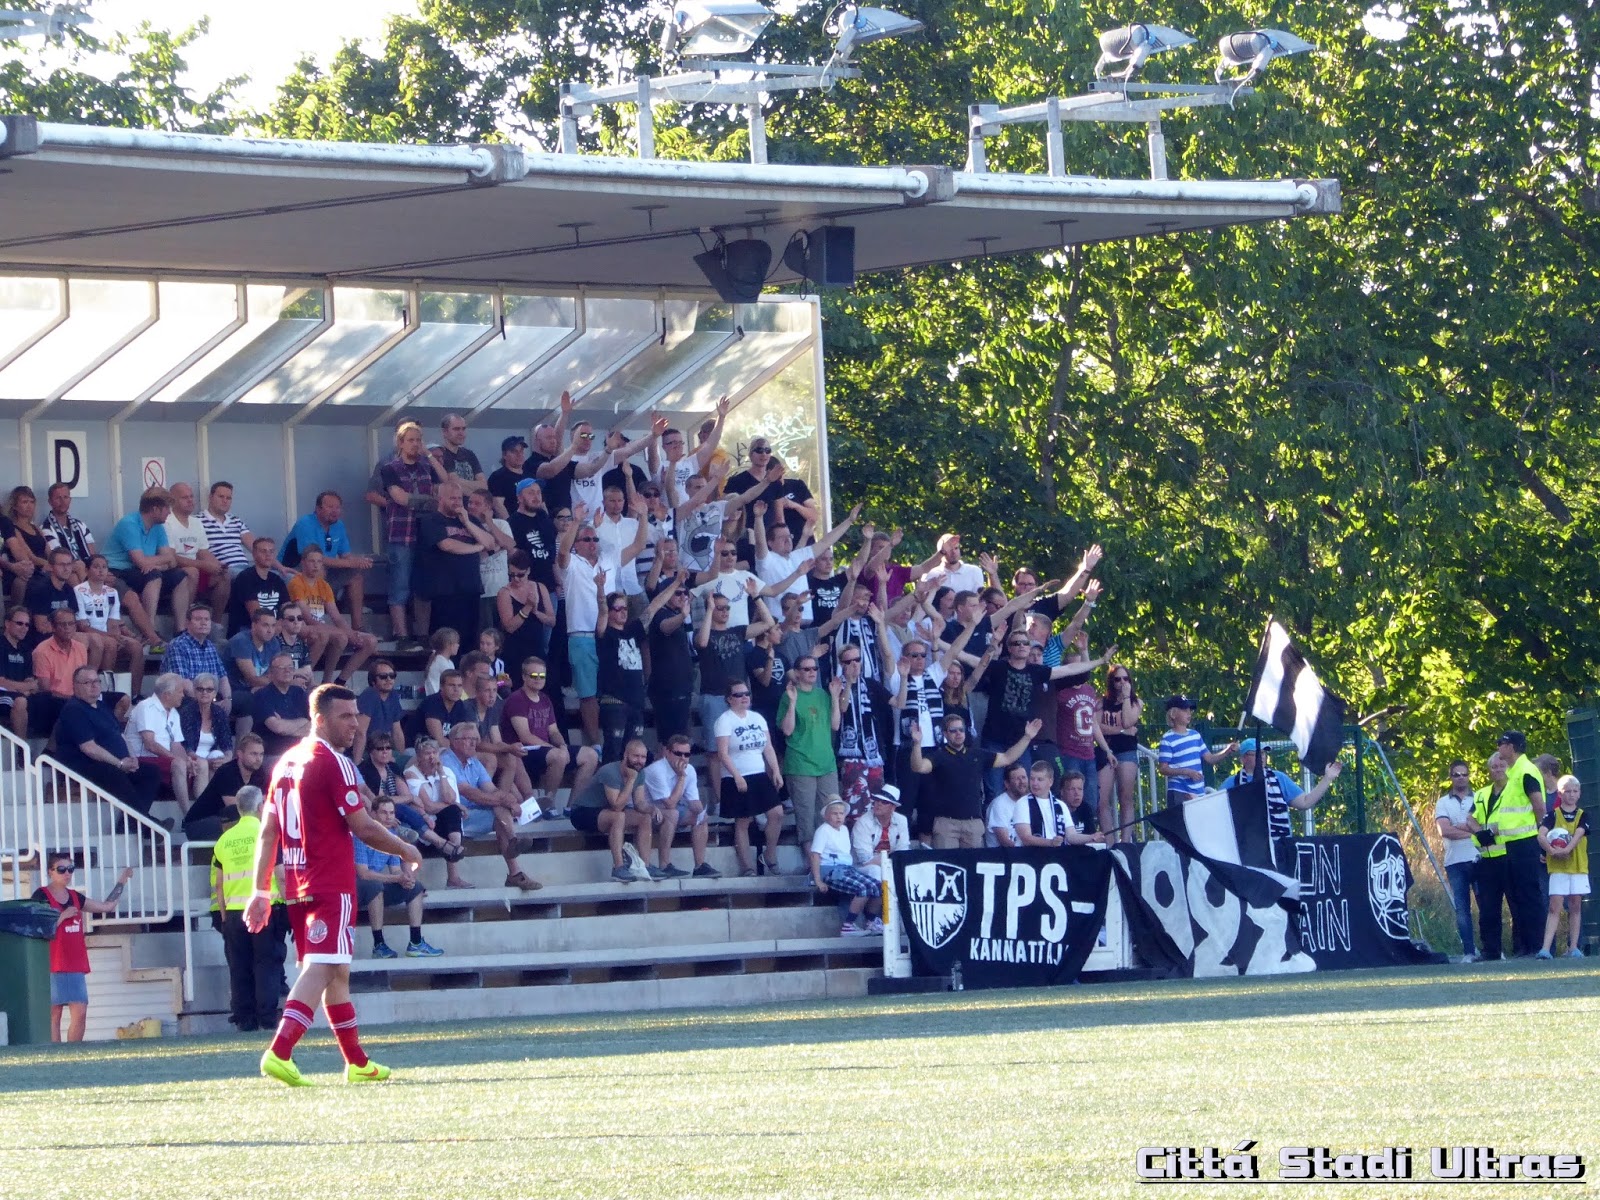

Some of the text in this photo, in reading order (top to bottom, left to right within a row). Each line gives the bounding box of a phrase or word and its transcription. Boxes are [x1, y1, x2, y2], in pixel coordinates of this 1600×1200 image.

[54, 439, 80, 490] D
[976, 862, 1095, 943] TPS-
[969, 937, 1069, 966] KANNATTAJ
